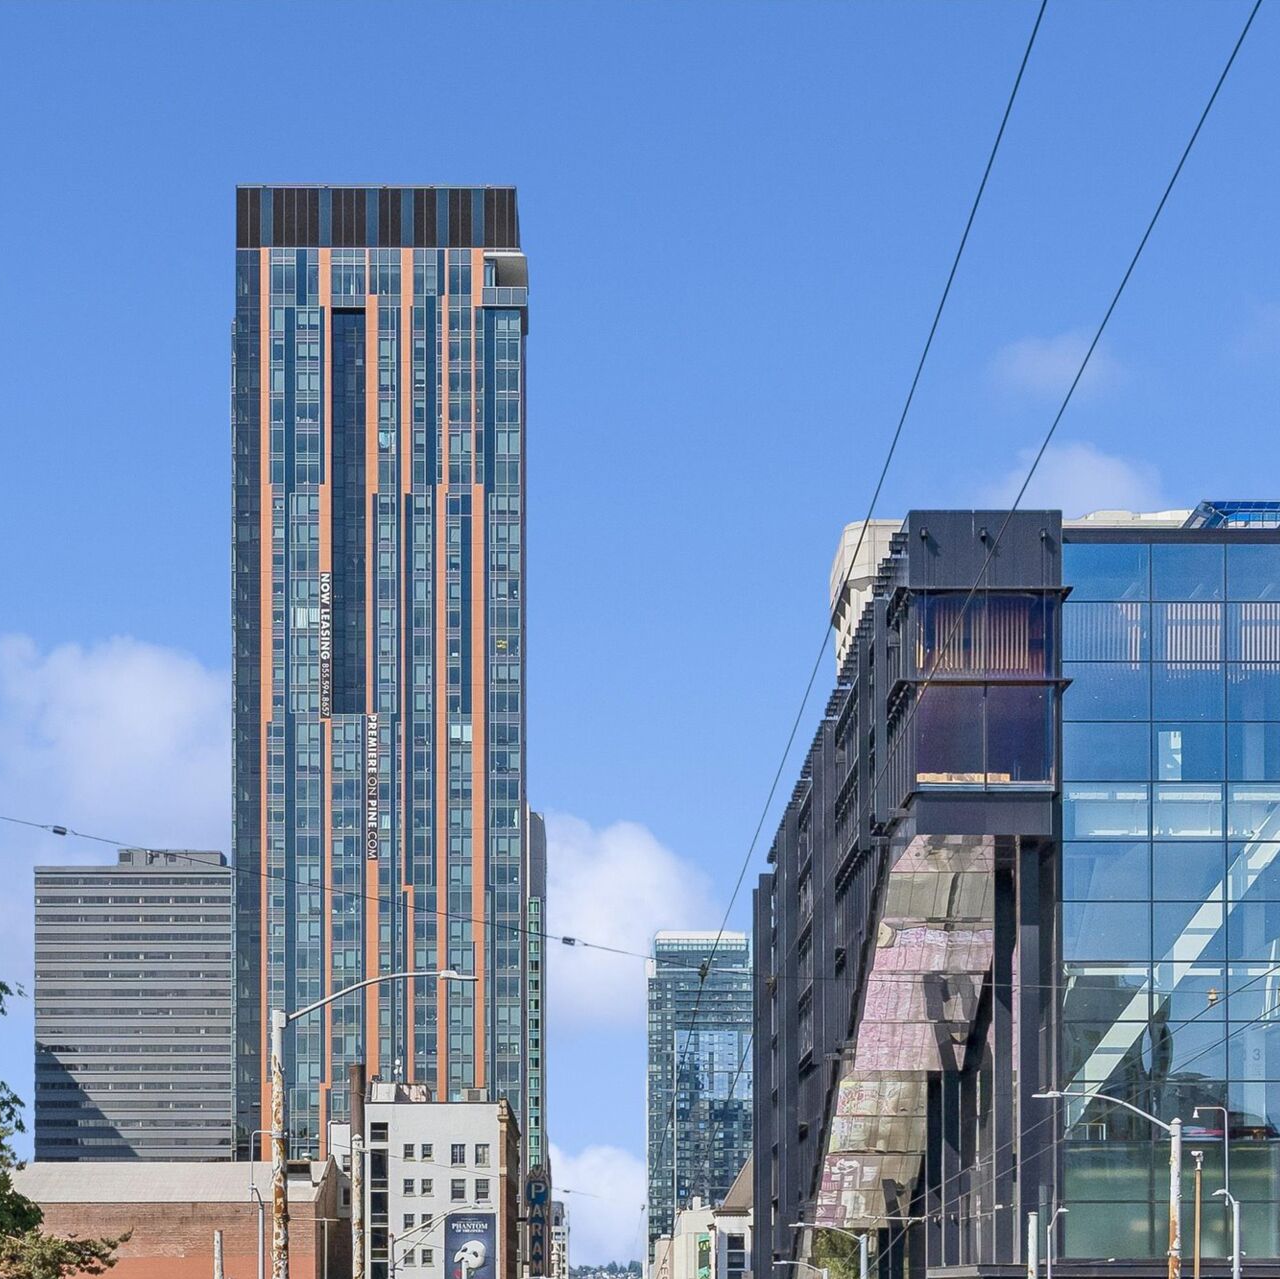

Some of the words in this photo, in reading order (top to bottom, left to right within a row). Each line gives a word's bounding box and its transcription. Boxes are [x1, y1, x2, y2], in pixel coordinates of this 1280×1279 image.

[320, 573, 330, 605] NOW
[320, 610, 331, 660] LEASING
[321, 663, 330, 717] 855.594.8657
[368, 714, 378, 774] PREMIERE
[368, 776, 377, 797] ON
